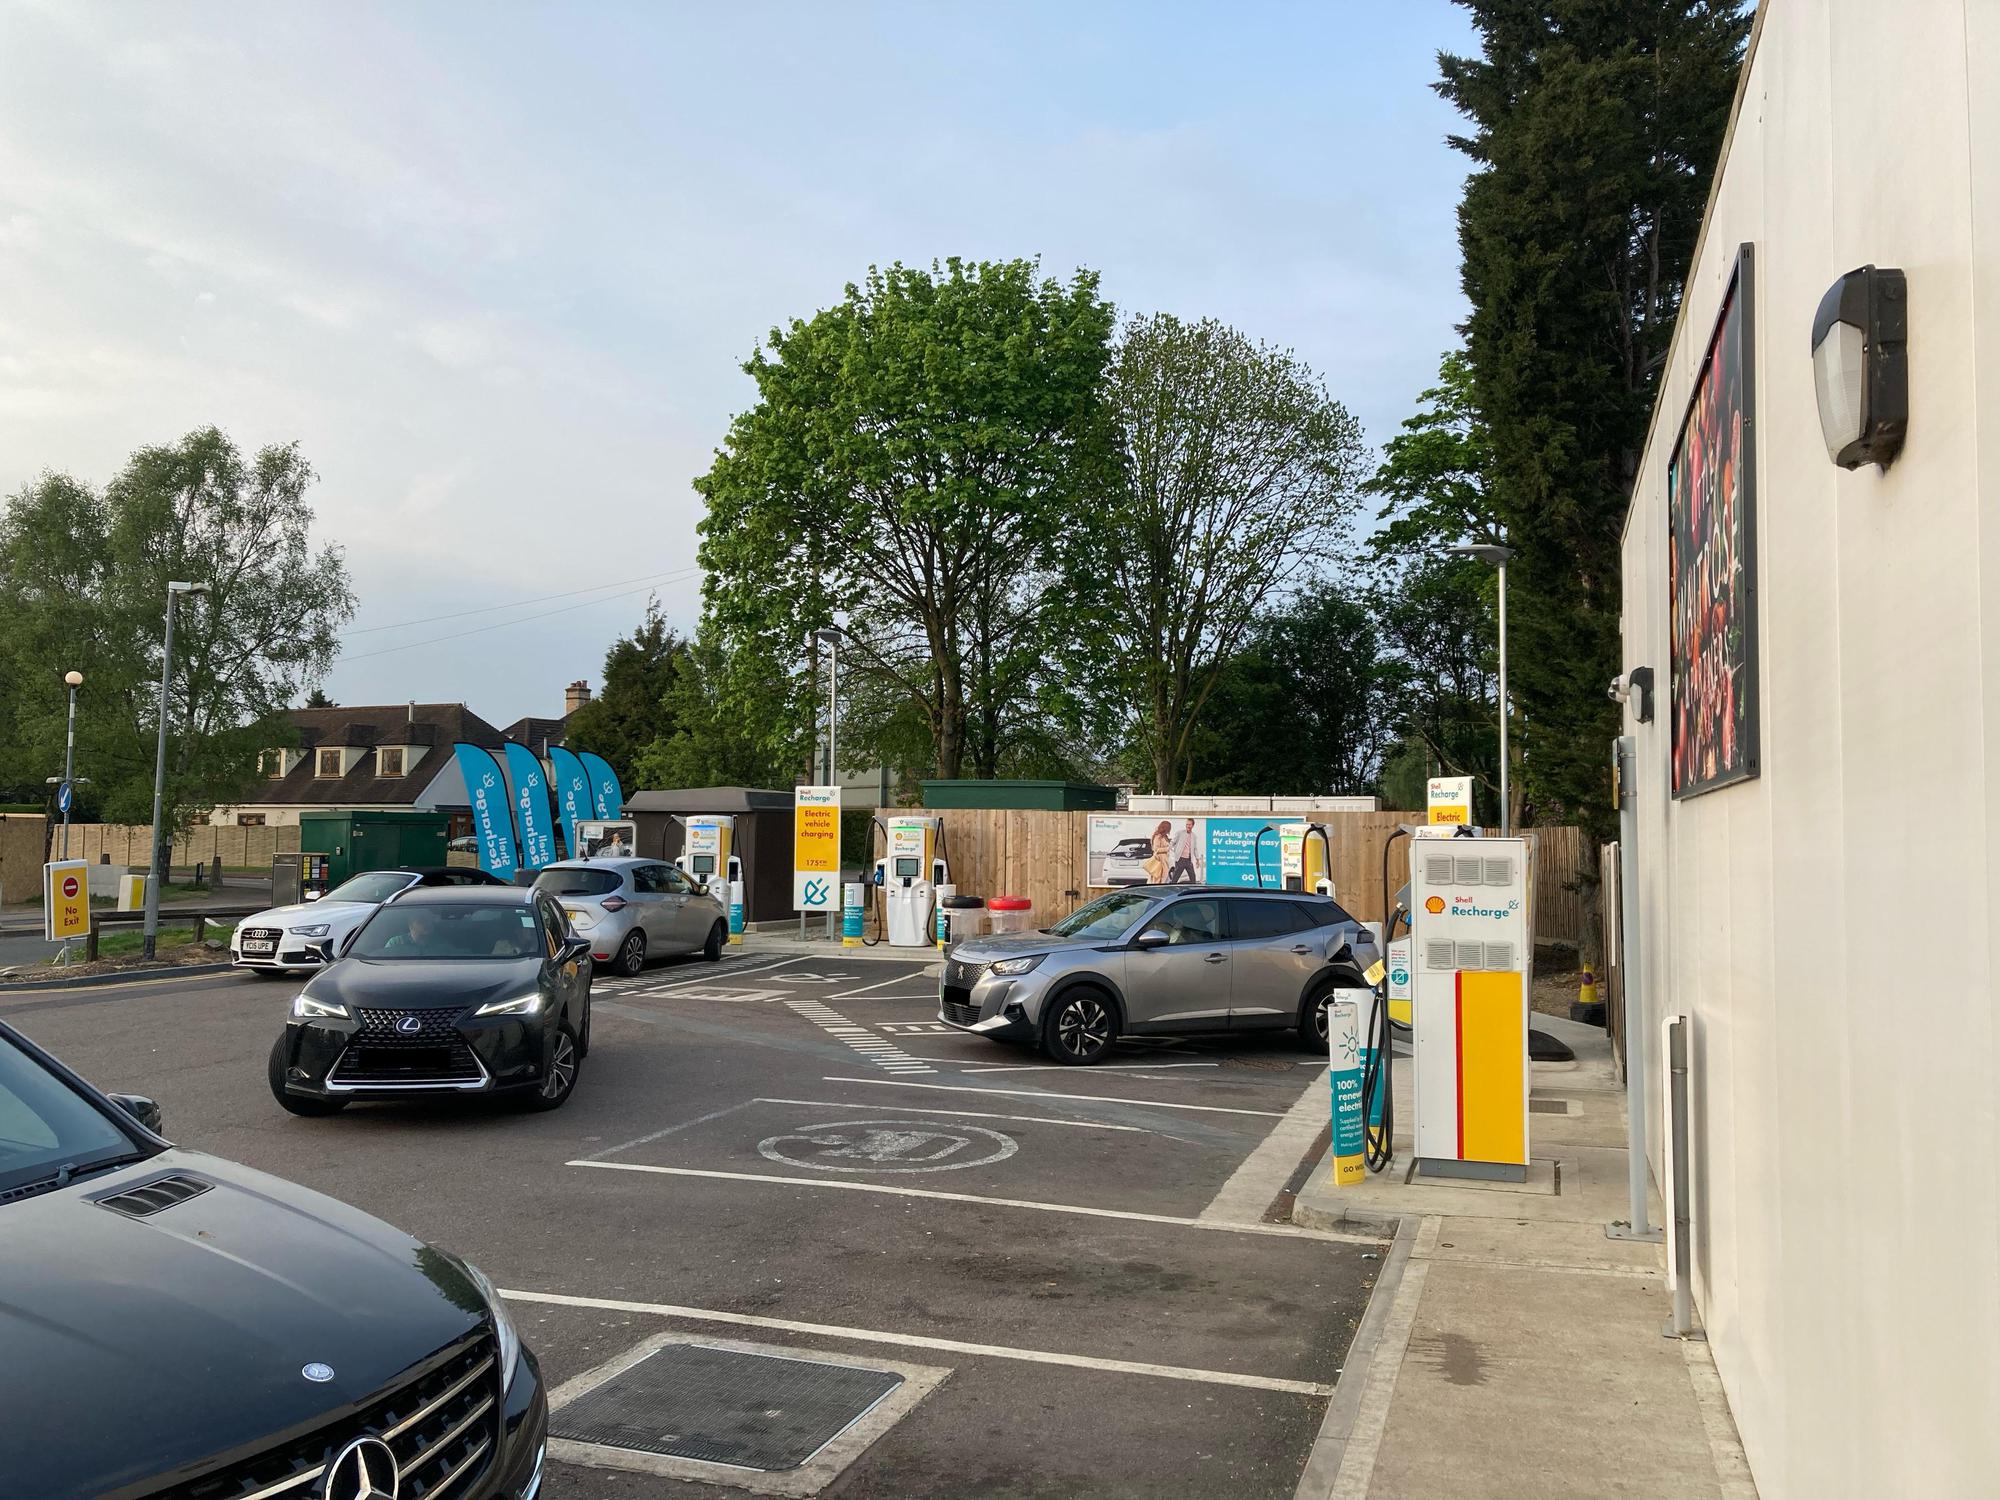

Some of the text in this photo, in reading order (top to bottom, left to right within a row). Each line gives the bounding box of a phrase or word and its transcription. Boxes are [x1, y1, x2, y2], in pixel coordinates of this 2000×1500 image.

[1678, 485, 1738, 647] WAITROSE
[1430, 790, 1459, 800] Recharge
[1436, 812, 1460, 822] Electric
[801, 830, 834, 839] charging
[1212, 830, 1242, 838] Making
[65, 906, 77, 915] No
[1452, 906, 1509, 919] Recharge
[64, 916, 79, 926] Exit
[1336, 1080, 1358, 1090] 100%
